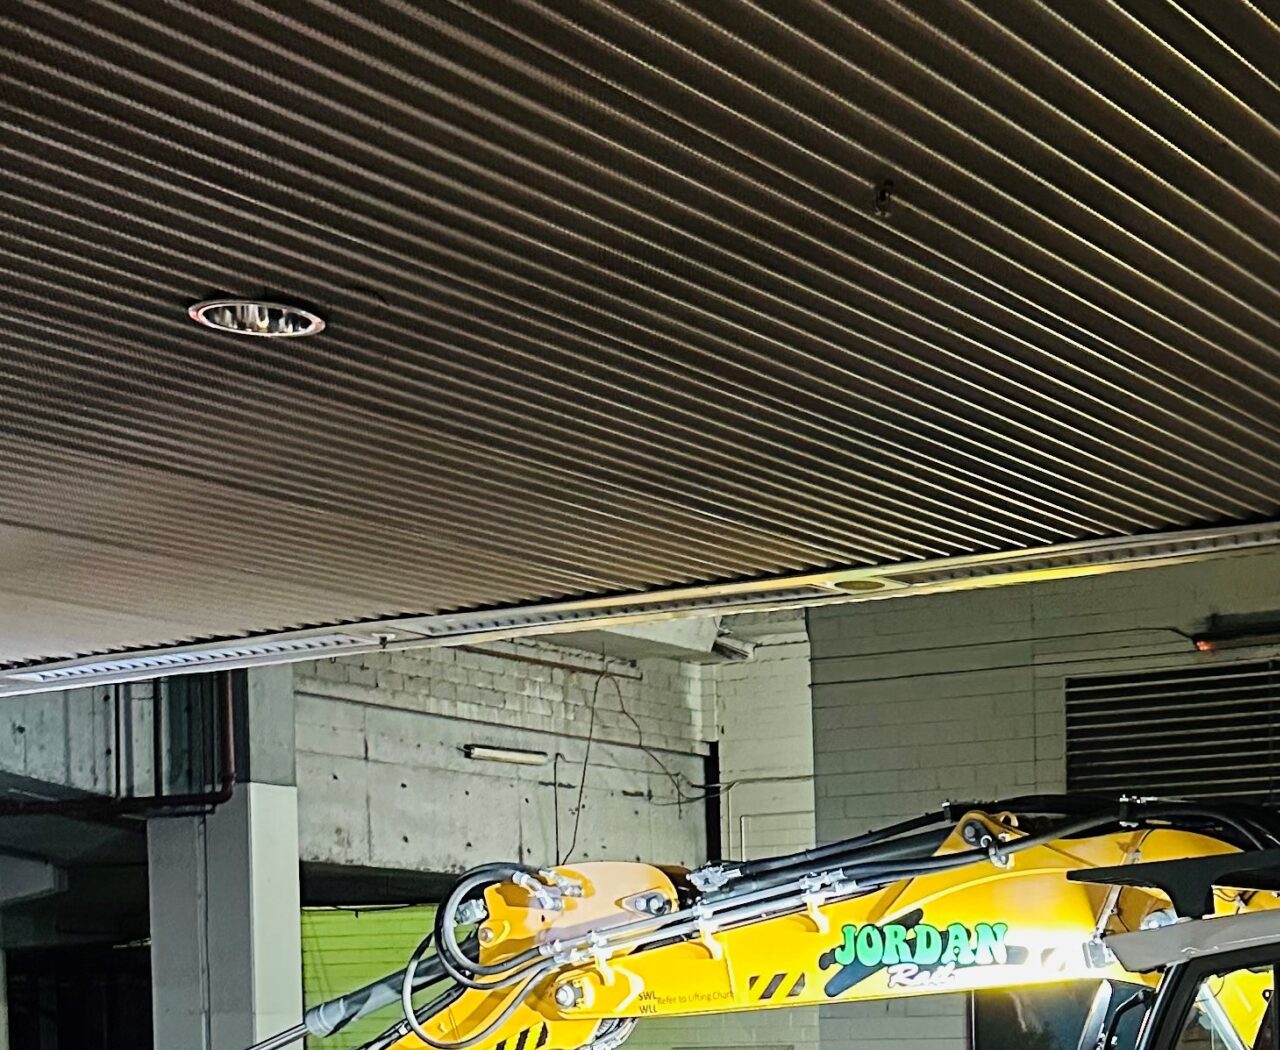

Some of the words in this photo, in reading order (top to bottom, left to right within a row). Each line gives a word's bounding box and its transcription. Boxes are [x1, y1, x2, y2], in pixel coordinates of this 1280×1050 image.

[834, 923, 1008, 967] JORDAN
[638, 990, 657, 1001] SWL
[678, 994, 687, 1003] to
[688, 991, 712, 1001] Lifting
[639, 1003, 658, 1014] WLL
